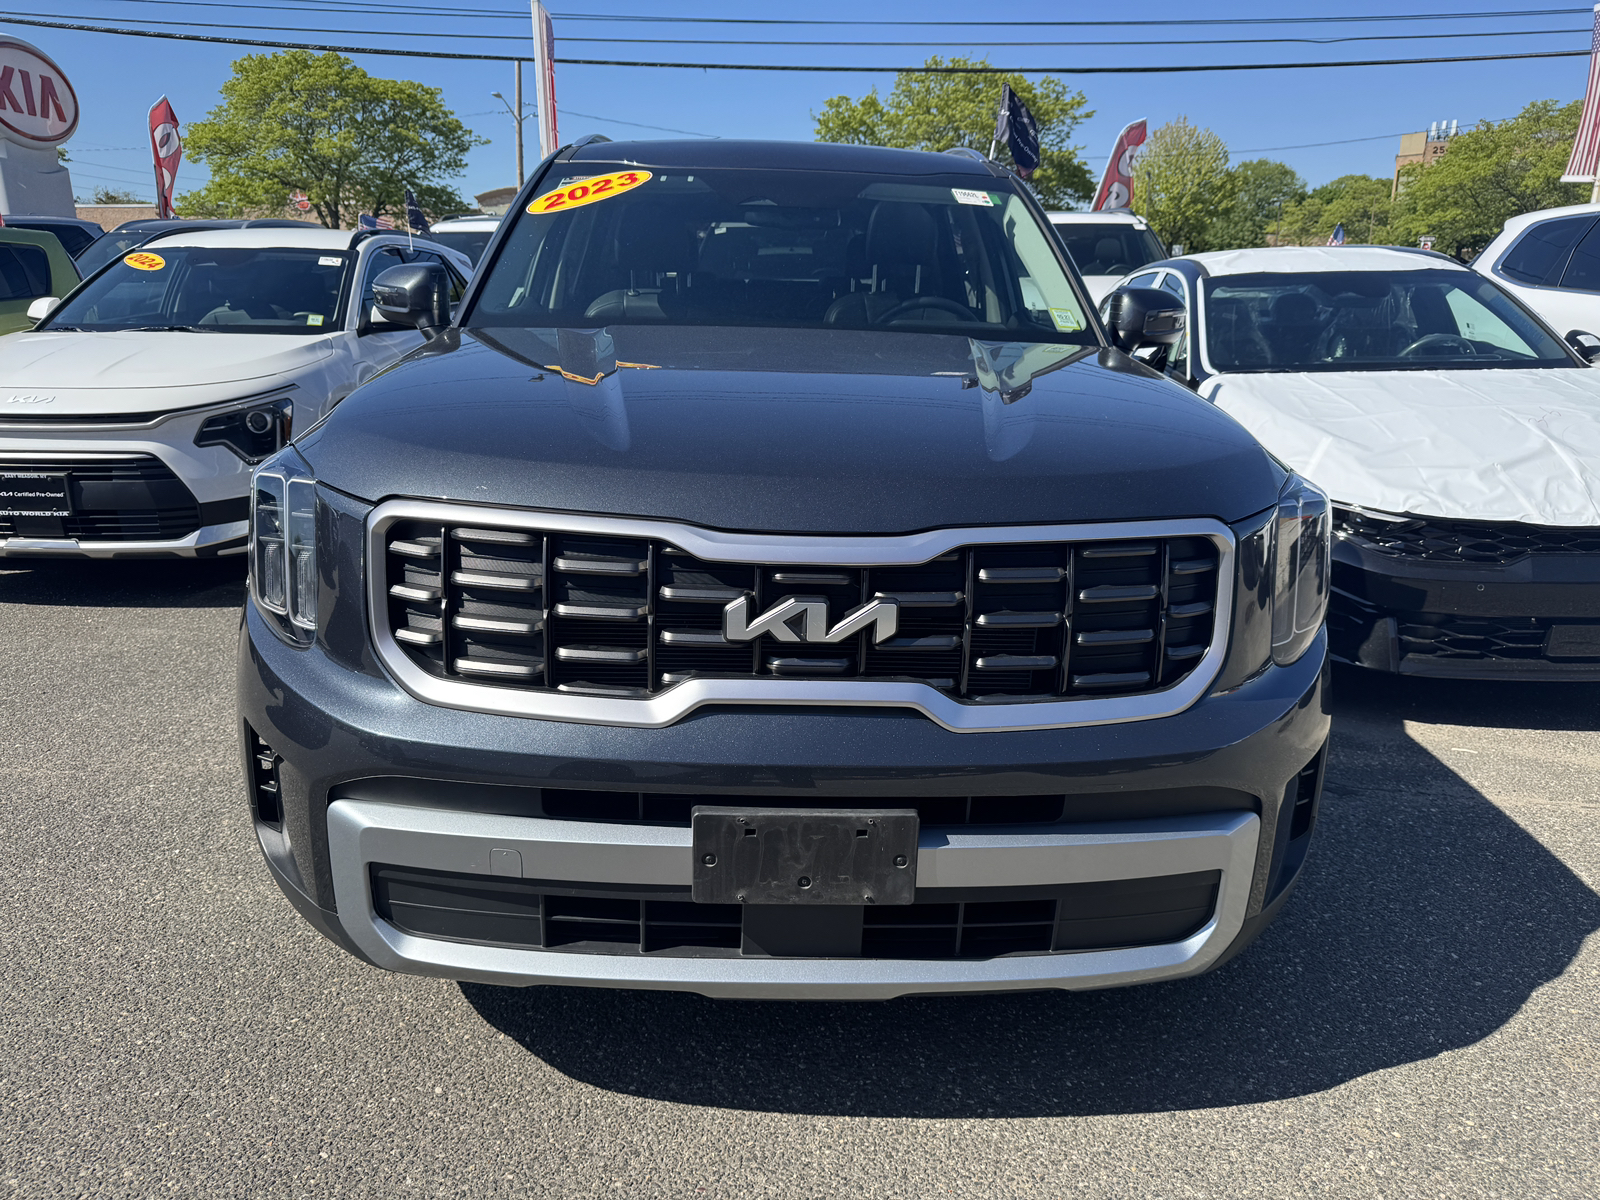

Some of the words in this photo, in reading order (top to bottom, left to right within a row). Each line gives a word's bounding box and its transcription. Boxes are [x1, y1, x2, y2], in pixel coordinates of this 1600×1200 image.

[0, 65, 67, 123] KIA
[1432, 145, 1449, 155] 25
[543, 172, 639, 211] 2023
[127, 254, 163, 268] 2024
[722, 594, 899, 645] KIA
